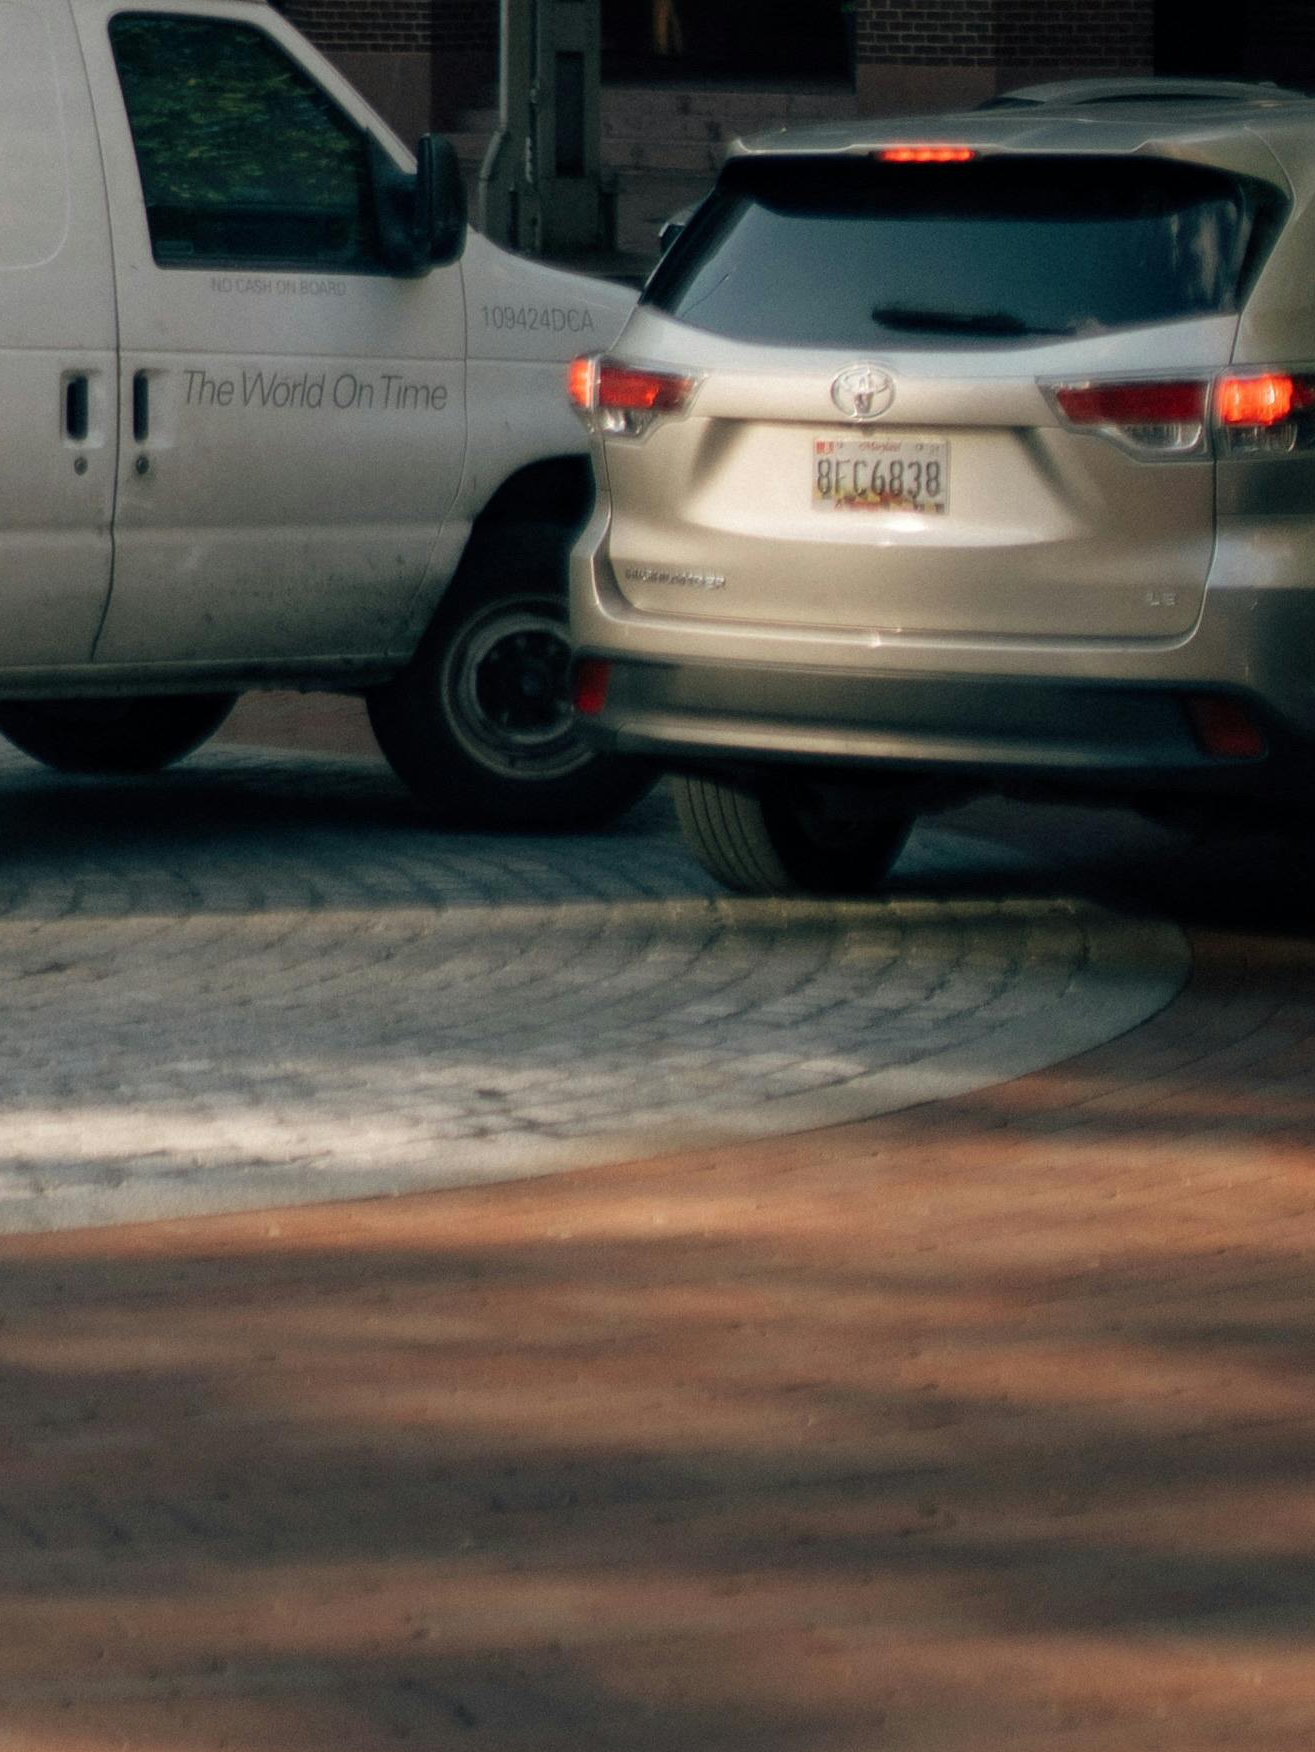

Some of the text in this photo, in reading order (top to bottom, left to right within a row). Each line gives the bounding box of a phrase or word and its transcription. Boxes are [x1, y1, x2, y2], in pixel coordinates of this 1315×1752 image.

[211, 277, 347, 296] NO CASH ON BOARD
[482, 305, 595, 333] 109424DCA
[183, 370, 448, 411] The World On Time
